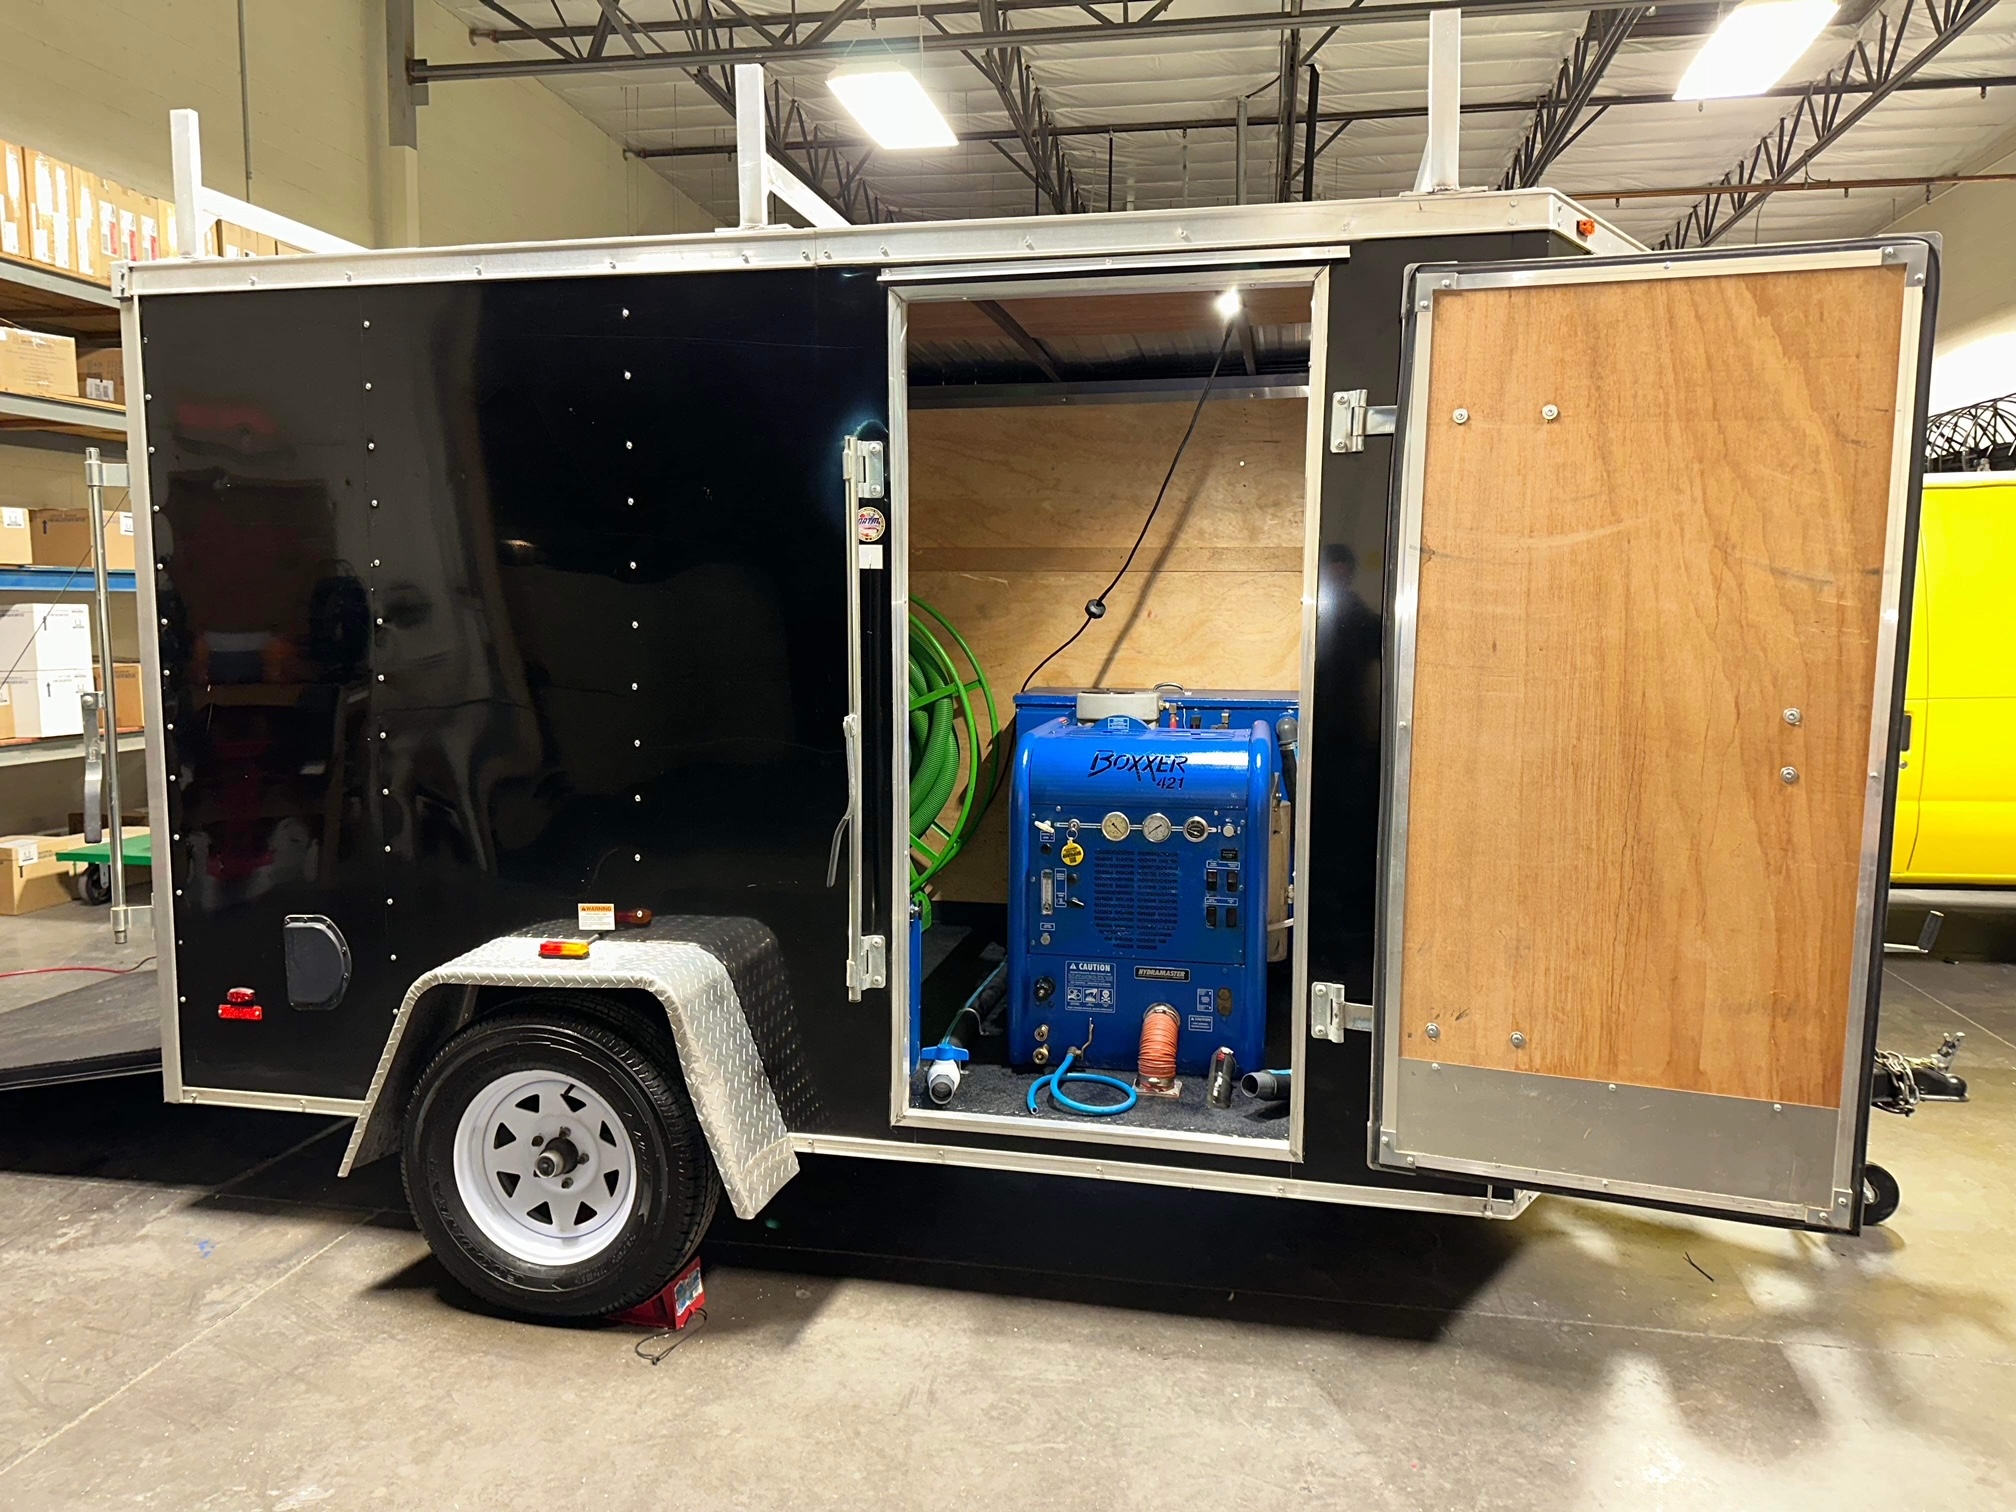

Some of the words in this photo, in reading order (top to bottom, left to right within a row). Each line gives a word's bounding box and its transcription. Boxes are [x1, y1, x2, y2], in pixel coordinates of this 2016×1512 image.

[1087, 750, 1188, 782] BOXXER
[1156, 777, 1185, 790] 421
[1078, 963, 1111, 972] CAUTION
[1138, 969, 1186, 977] HYDRAMASTER
